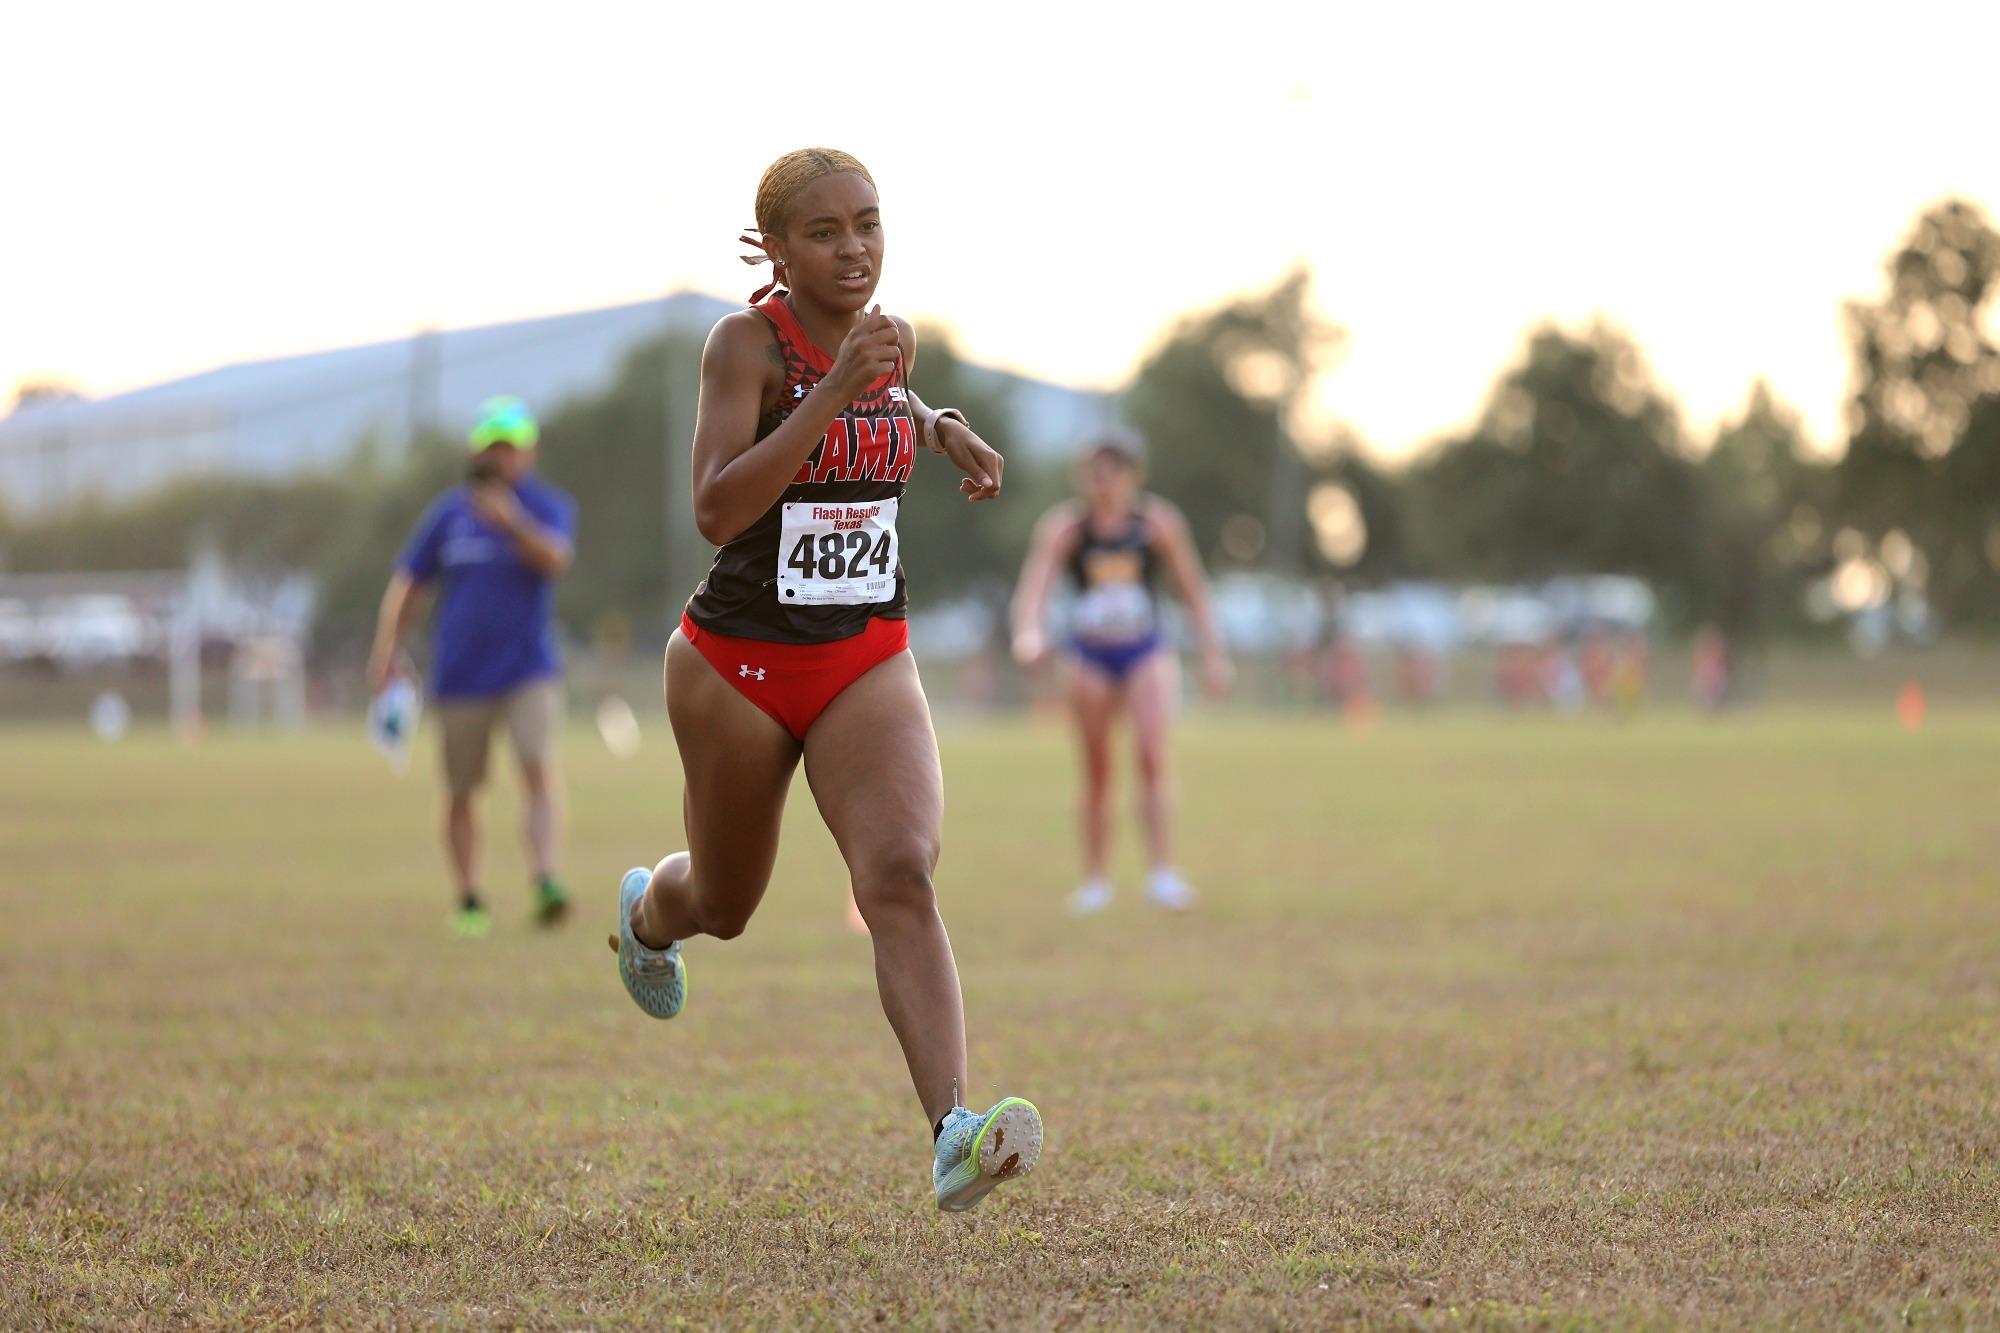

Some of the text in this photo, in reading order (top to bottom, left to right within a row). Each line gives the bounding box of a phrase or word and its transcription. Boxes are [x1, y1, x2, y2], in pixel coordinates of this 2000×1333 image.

[785, 416, 917, 484] AMA
[812, 506, 881, 520] Flash Results
[833, 520, 863, 531] Texas
[787, 530, 891, 580] 4824
